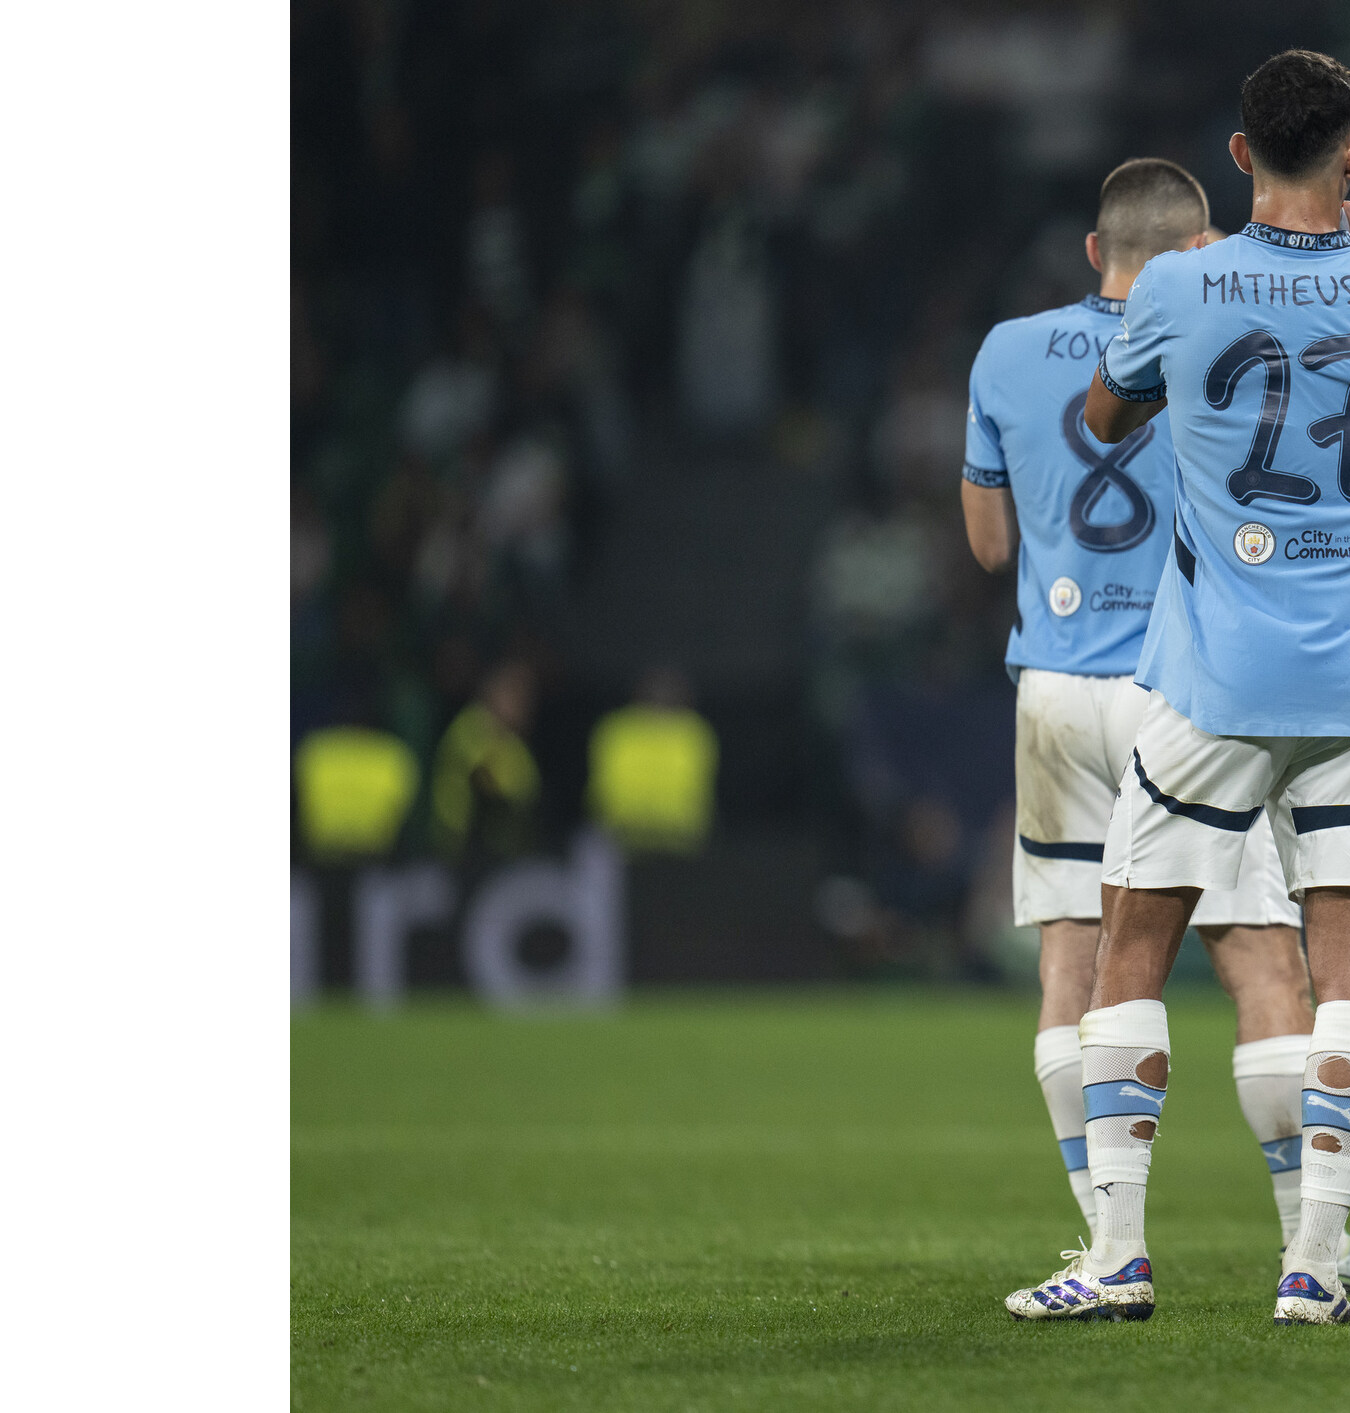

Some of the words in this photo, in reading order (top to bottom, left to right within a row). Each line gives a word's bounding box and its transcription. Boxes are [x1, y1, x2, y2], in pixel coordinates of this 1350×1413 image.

[1045, 328, 1117, 360] KOV
[1061, 388, 1156, 554] 8
[1238, 524, 1272, 539] MANCHESTER
[1301, 530, 1333, 545] City
[1104, 583, 1133, 599] City
[1090, 590, 1154, 613] Commun
